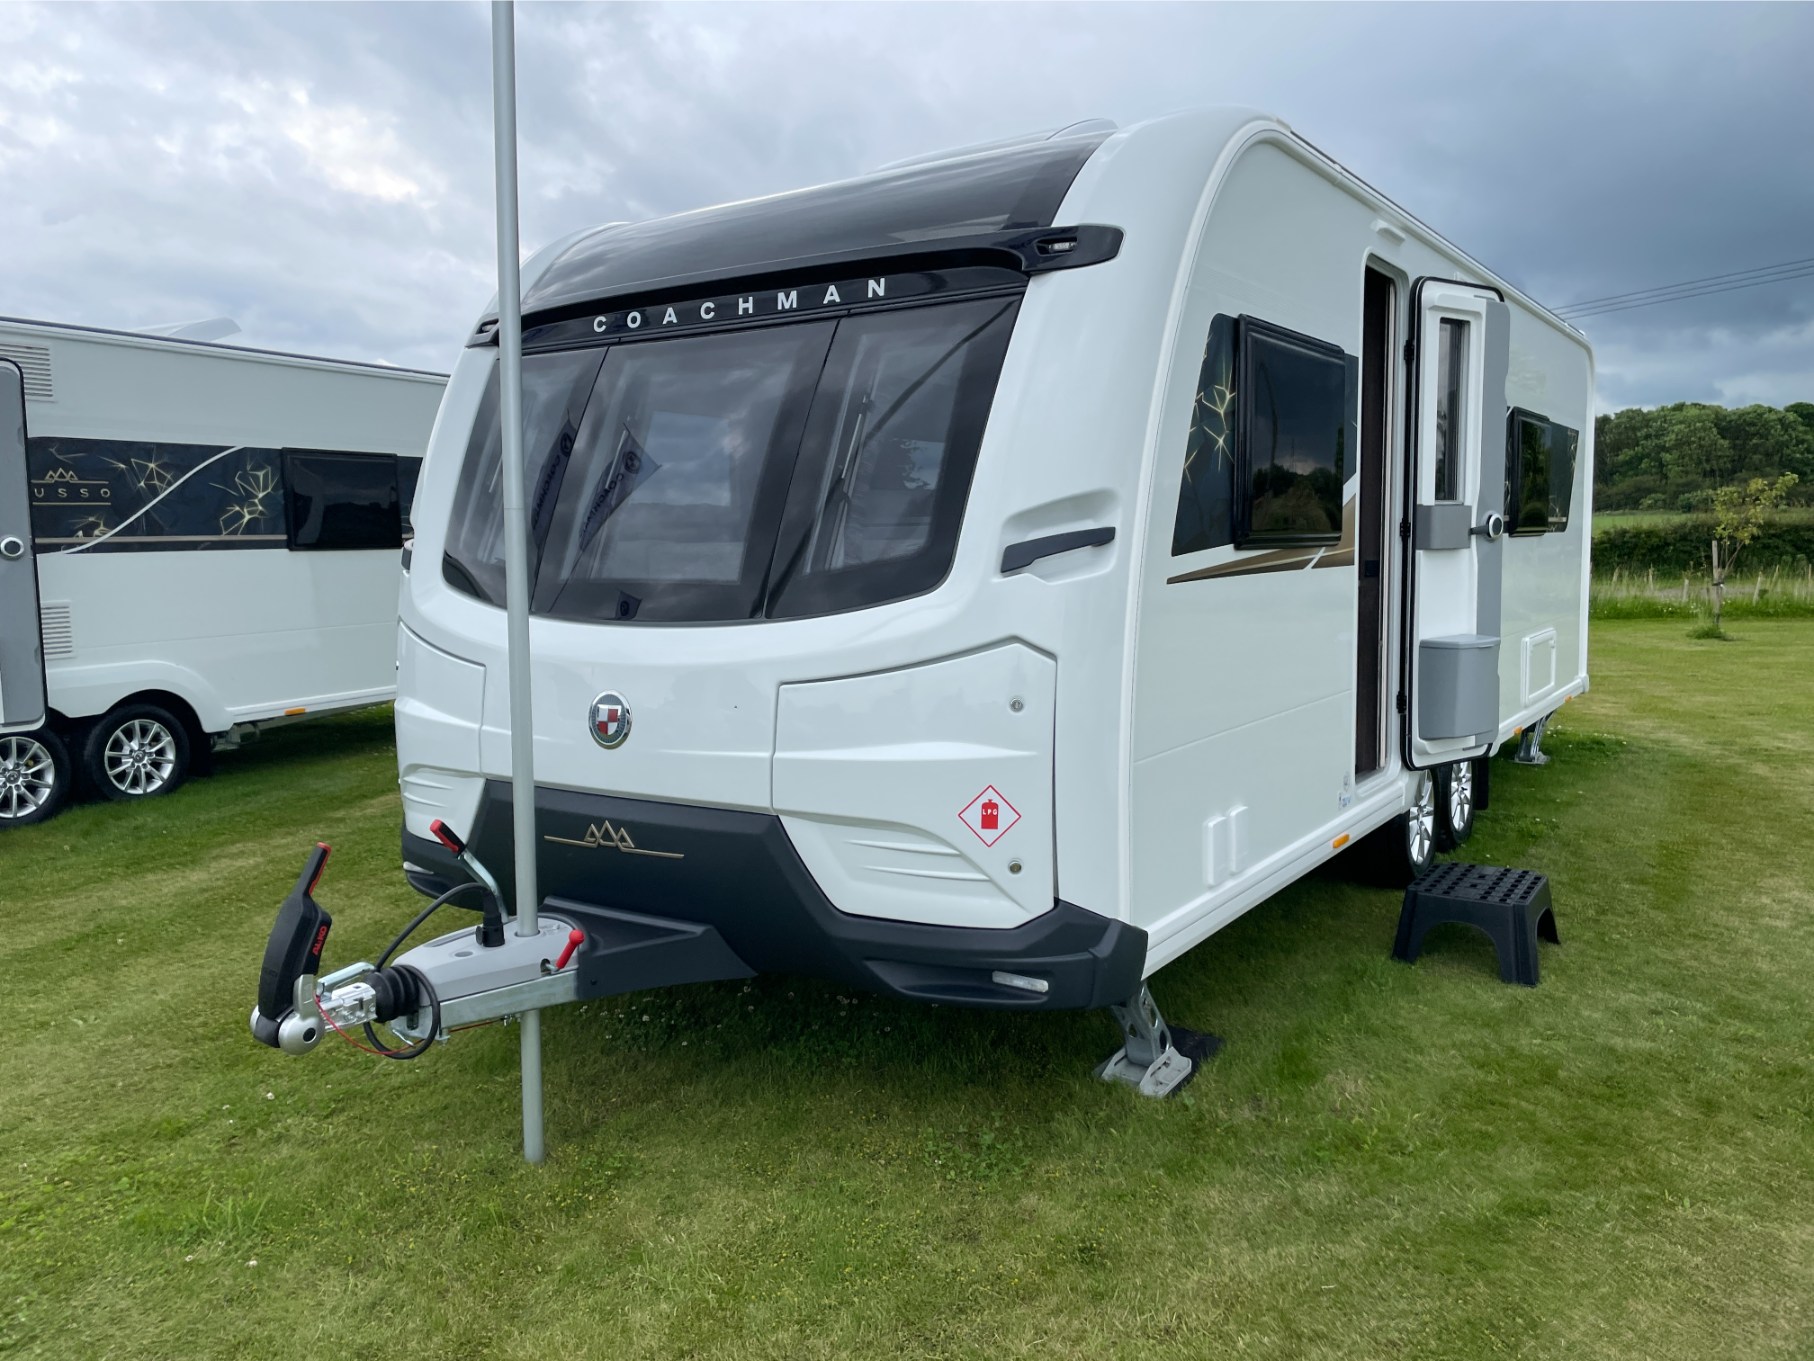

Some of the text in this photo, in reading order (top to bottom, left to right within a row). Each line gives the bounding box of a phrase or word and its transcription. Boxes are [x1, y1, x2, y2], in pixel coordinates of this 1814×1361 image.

[593, 277, 885, 332] COACHMAN
[34, 487, 111, 498] USSO
[982, 808, 998, 816] LPG
